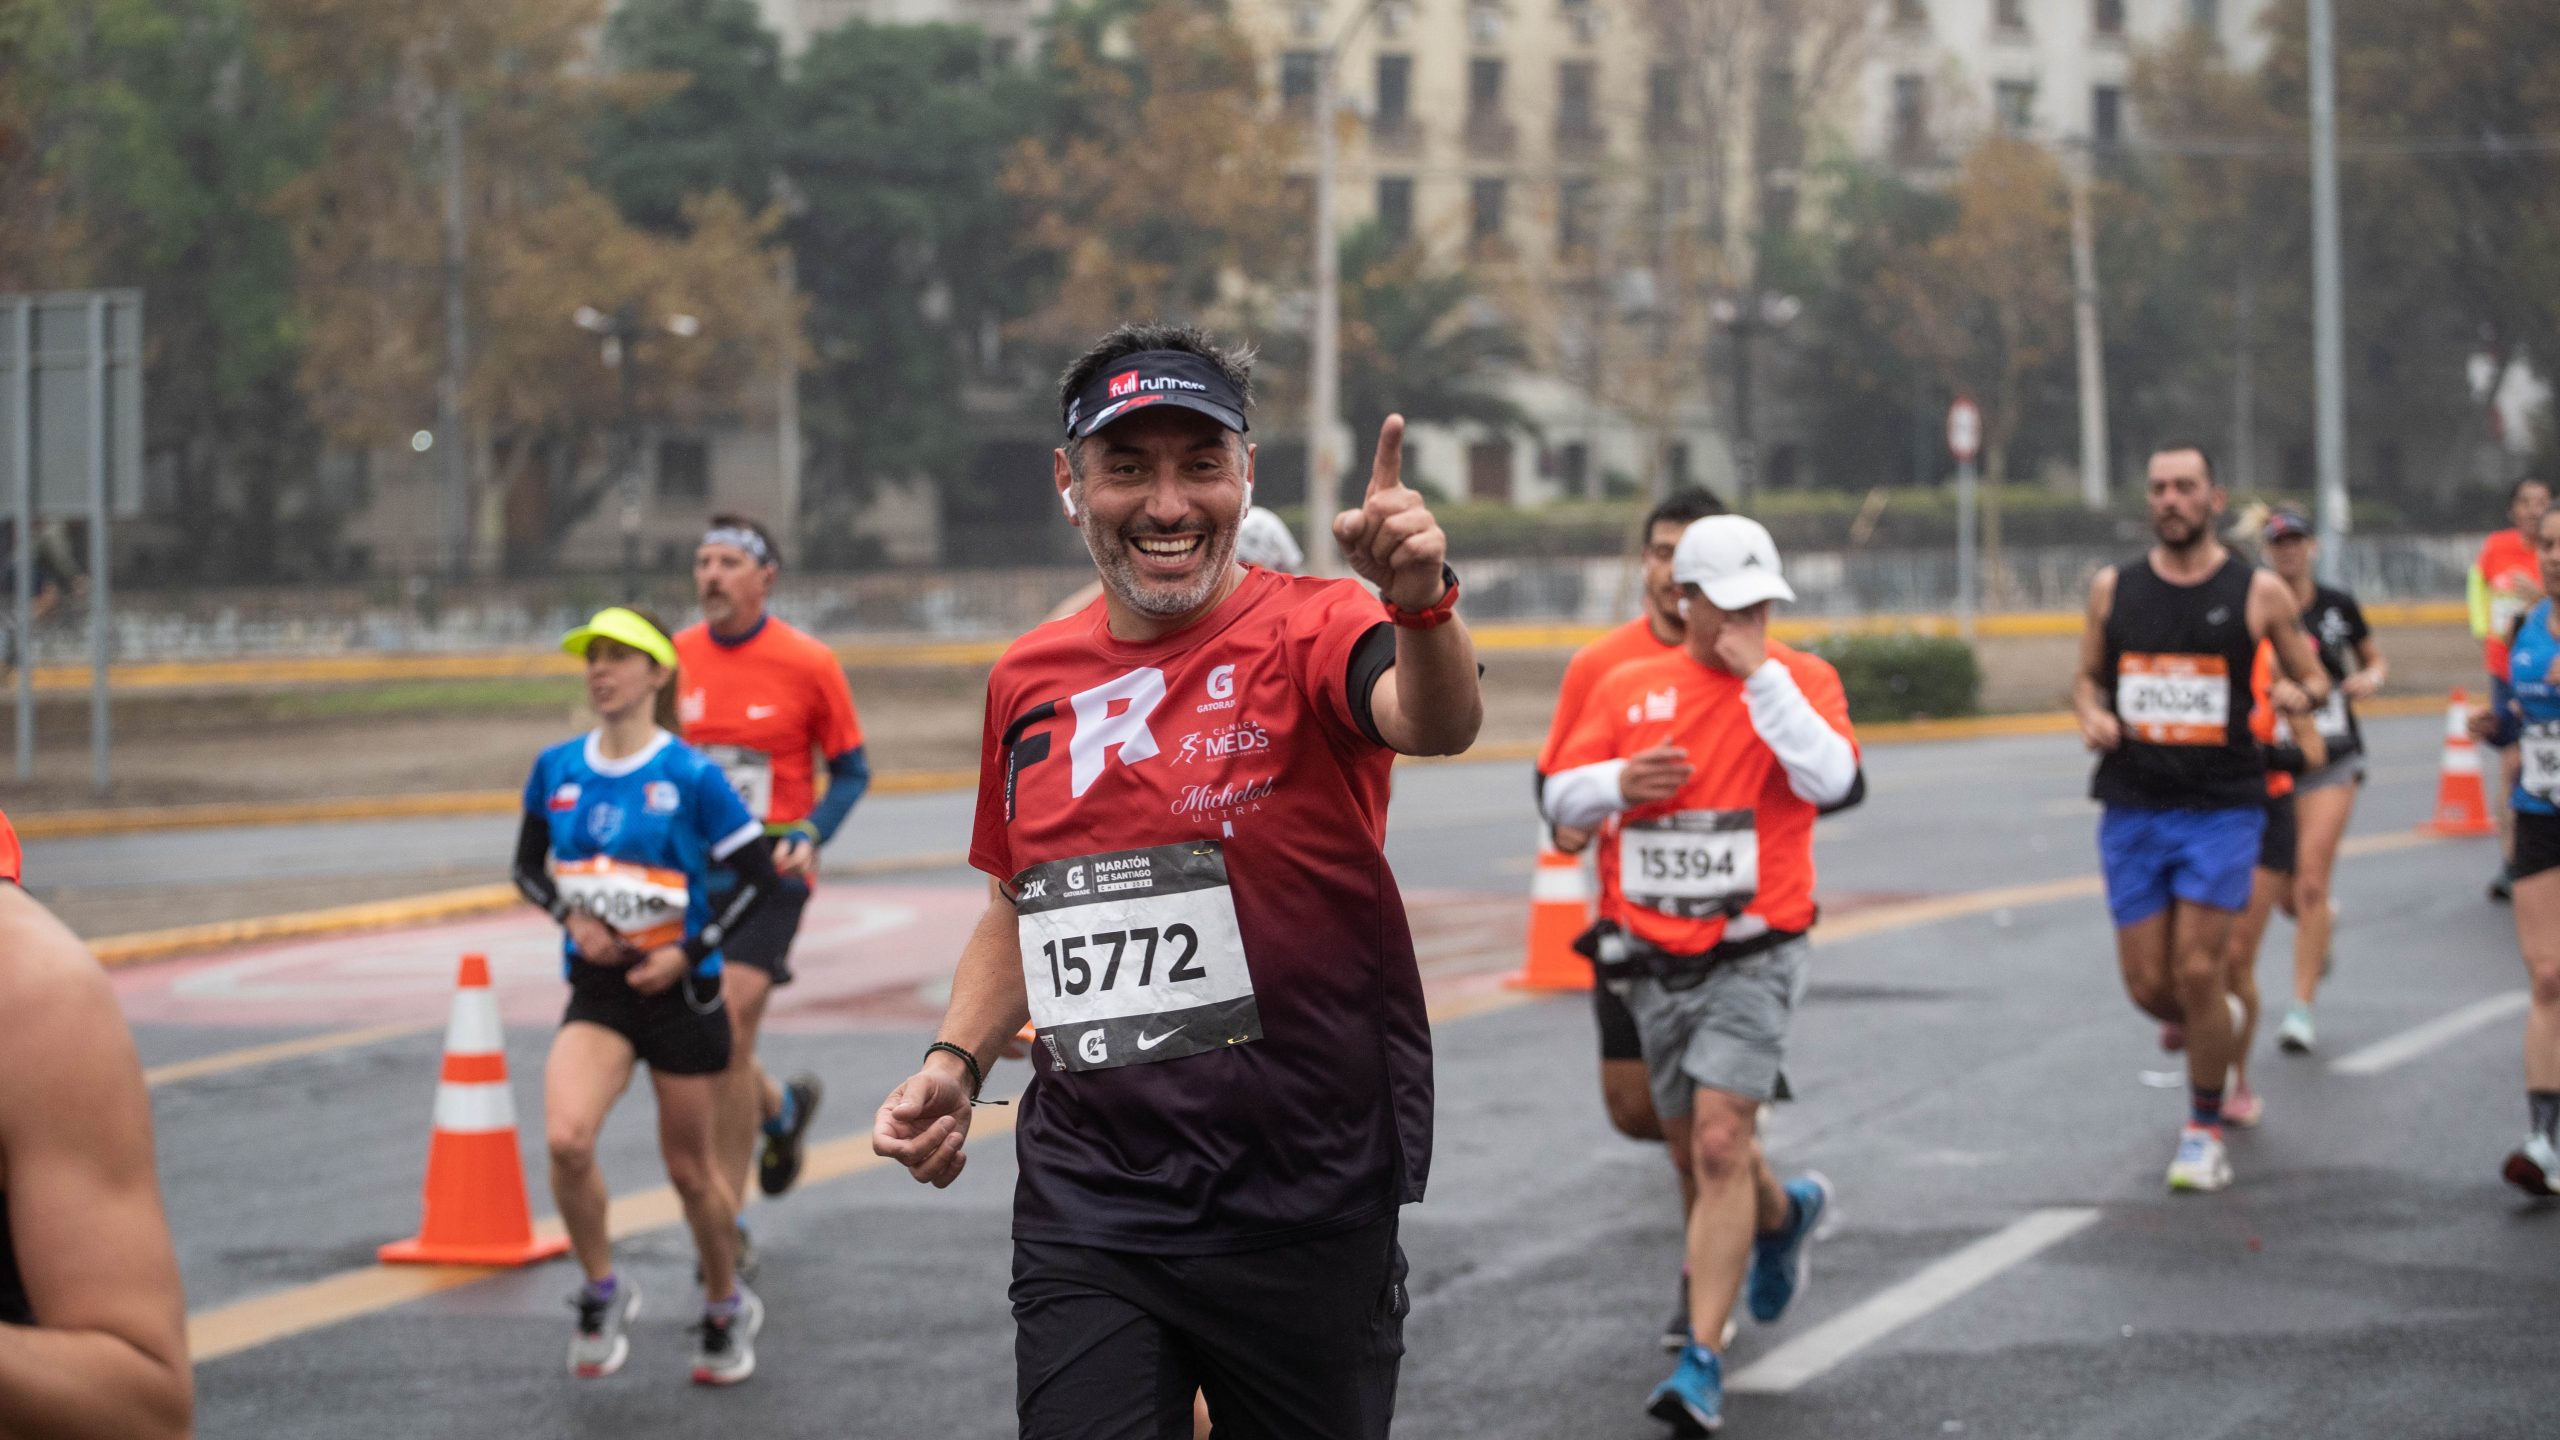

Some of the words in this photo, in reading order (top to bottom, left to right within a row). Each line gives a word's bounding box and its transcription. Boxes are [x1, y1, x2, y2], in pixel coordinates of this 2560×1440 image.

[1110, 373, 1136, 397] full
[1140, 376, 1206, 391] runners
[1206, 728, 1269, 757] MEDS
[1170, 776, 1274, 815] Michelob
[1192, 802, 1261, 823] ULTRA
[1095, 855, 1150, 873] MARATÓN
[1640, 847, 1734, 880] 15394
[1096, 874, 1109, 883] DE
[1110, 869, 1152, 881] SANTIAGO
[1022, 878, 1047, 900] 21K
[1042, 922, 1206, 998] 15772
